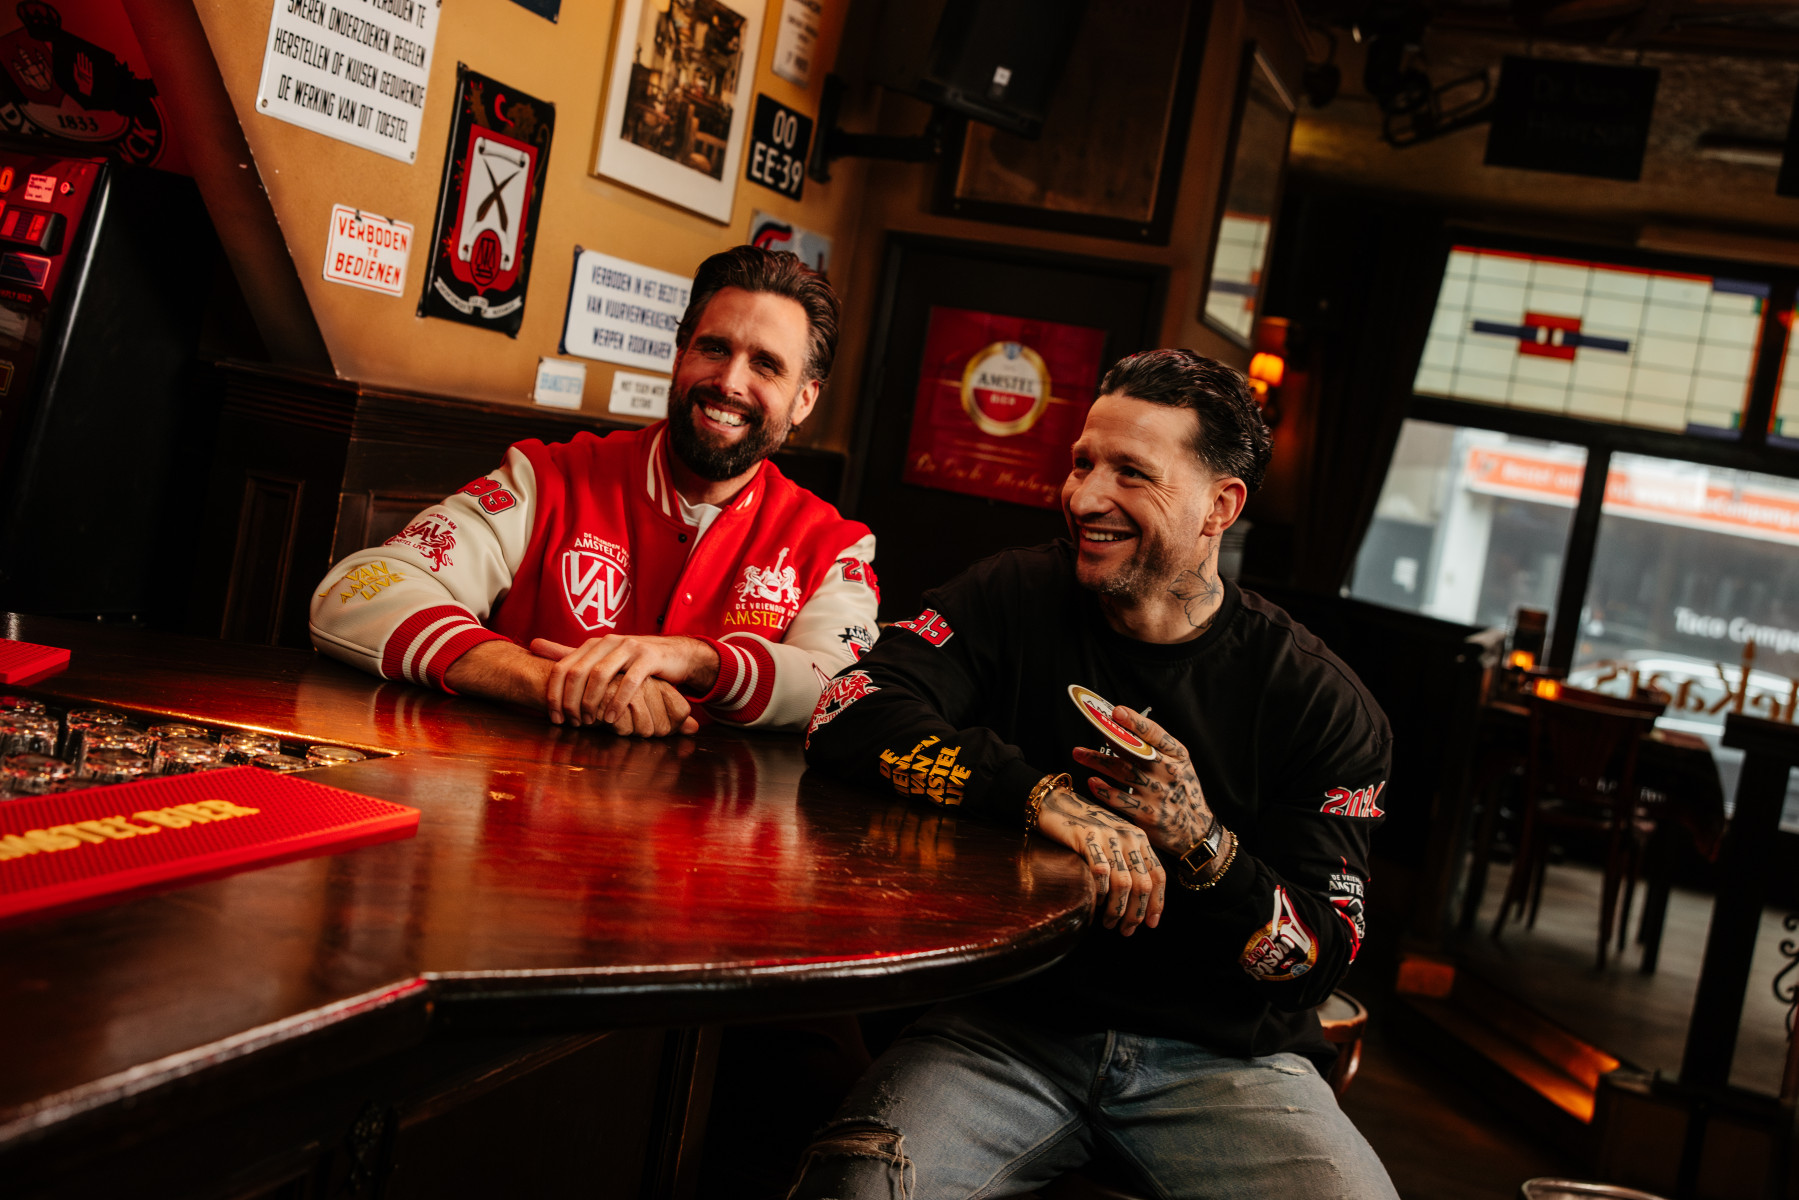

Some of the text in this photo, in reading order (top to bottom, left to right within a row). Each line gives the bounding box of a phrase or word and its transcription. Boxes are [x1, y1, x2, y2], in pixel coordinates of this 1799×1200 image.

[416, 4, 426, 28] TE
[274, 27, 425, 109] HERSTELLEN OF KUISEN GEDURENDE
[278, 74, 409, 144] DE WERKING VAN DIT TOESTEL
[58, 115, 98, 133] 1833
[772, 109, 798, 150] 00
[339, 215, 408, 253] VERBODEN
[367, 247, 379, 258] TE
[335, 252, 401, 287] BEDIENEN
[592, 264, 632, 292] VERBODEN
[587, 295, 602, 316] VAN
[978, 373, 1034, 394] AMSTEL
[574, 537, 616, 559] AMSTEL
[346, 560, 390, 581] VAN
[911, 754, 935, 795] VAN
[945, 764, 972, 806] LIVE
